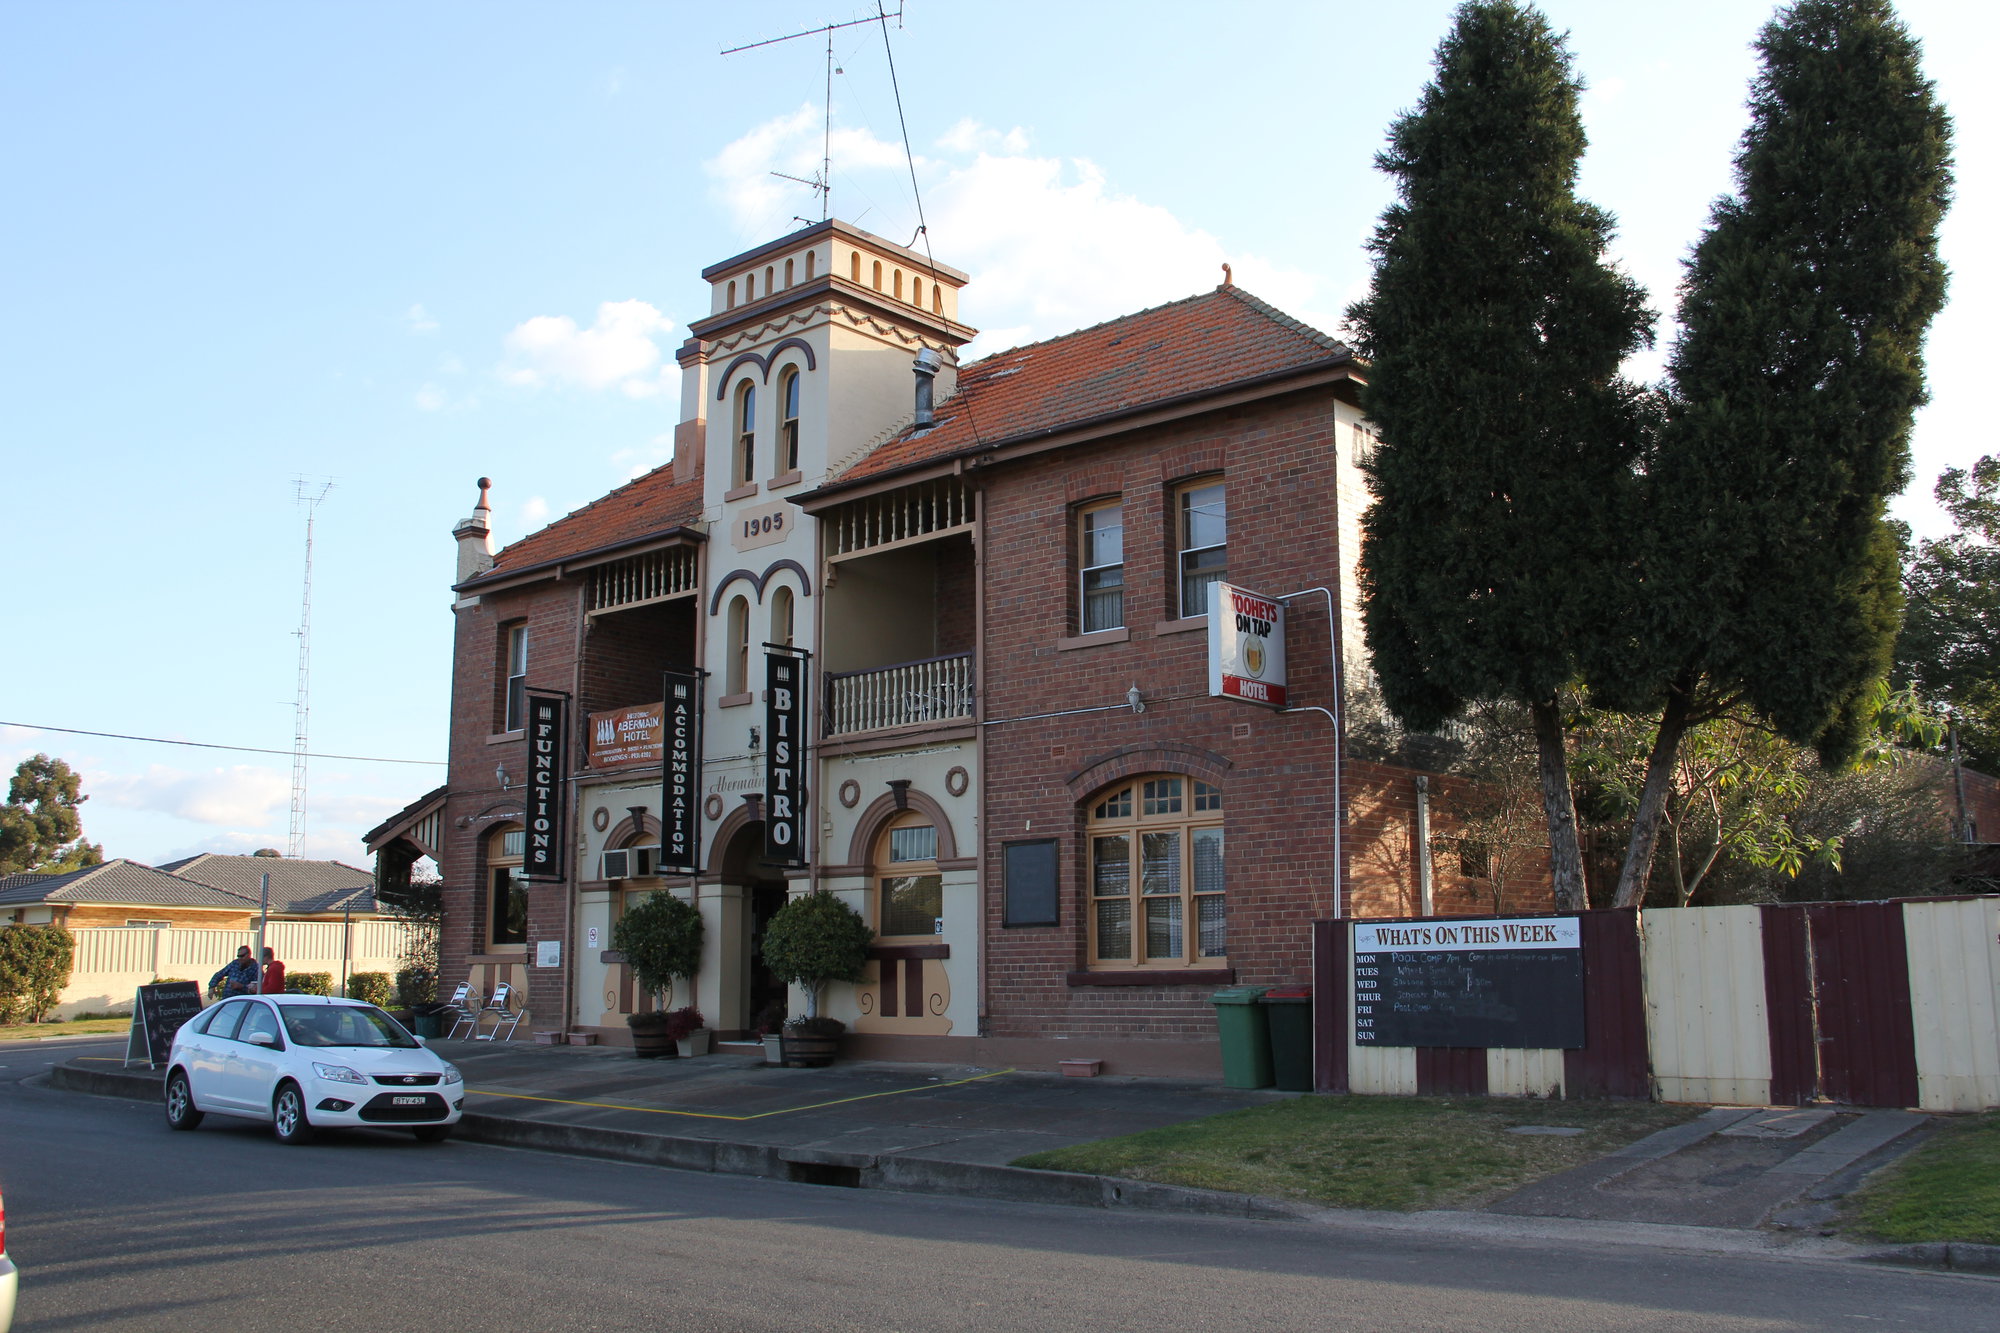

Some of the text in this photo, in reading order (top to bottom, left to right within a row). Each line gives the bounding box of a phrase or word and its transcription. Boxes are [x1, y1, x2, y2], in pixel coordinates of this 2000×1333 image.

[744, 512, 783, 538] 1905
[1231, 593, 1277, 623] TOOHEYS
[1235, 614, 1271, 638] ON TAP
[1240, 680, 1269, 700] HOTEL
[617, 717, 659, 732] ABERMAIN
[623, 730, 651, 742] HOTEL
[773, 687, 793, 846] BISTRO
[671, 703, 688, 855] ACCOMMODATION
[534, 724, 553, 864] FUNCTIONS
[1376, 924, 1557, 946] WHAT'S ON THIS WEEK
[1356, 955, 1376, 963] MON
[1356, 967, 1379, 976] TUES
[1357, 980, 1377, 989] WED
[1356, 993, 1381, 1001] THUR
[1357, 1005, 1372, 1014] FRI
[1357, 1018, 1374, 1027] SAT
[1357, 1031, 1375, 1040] SUN
